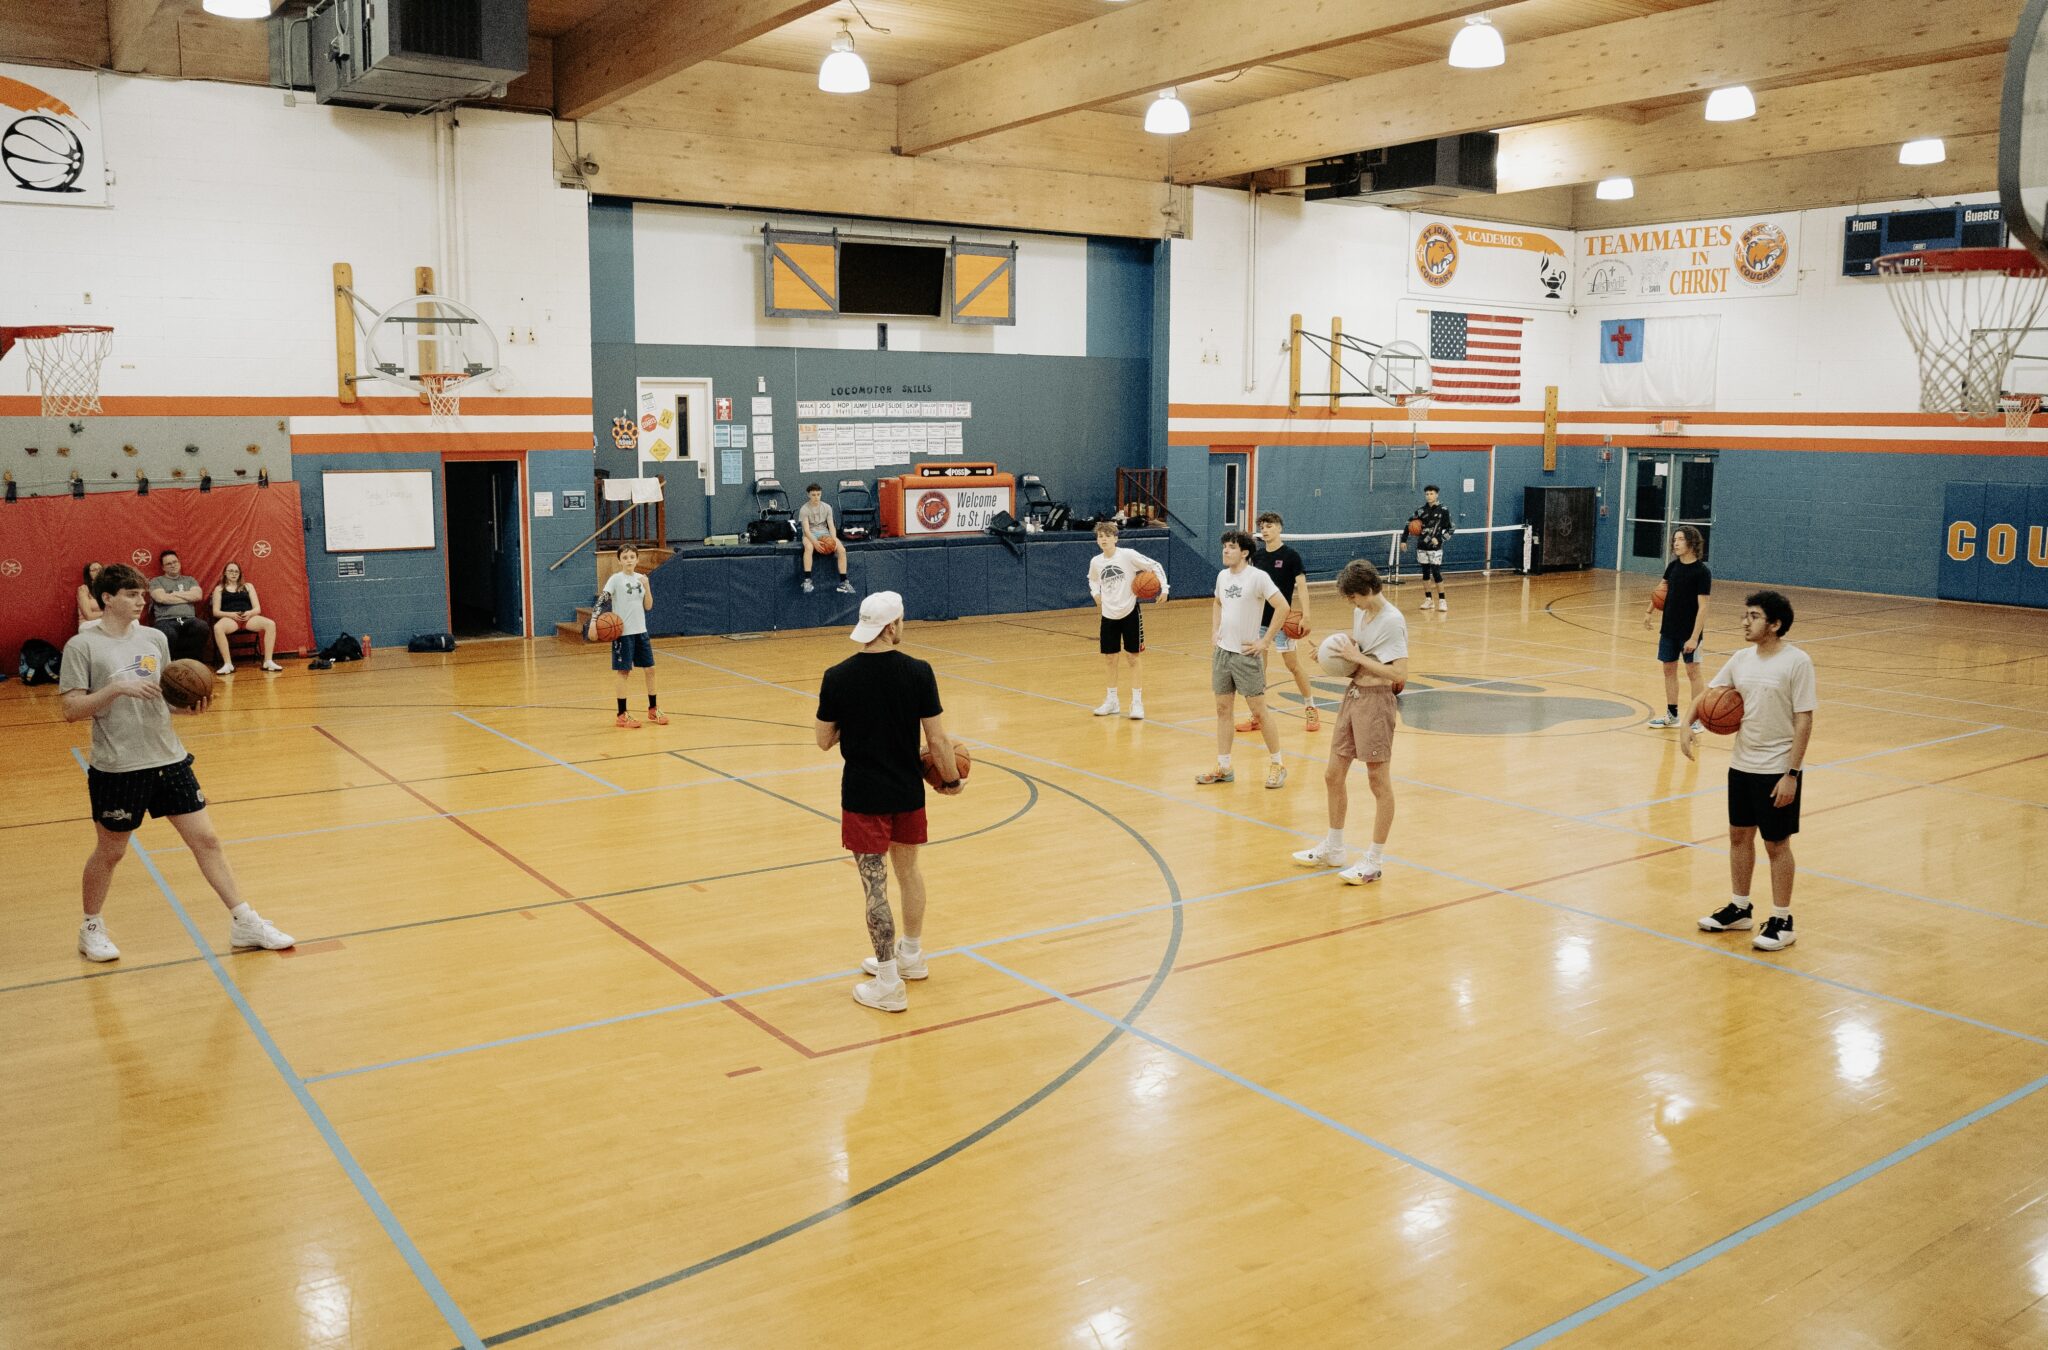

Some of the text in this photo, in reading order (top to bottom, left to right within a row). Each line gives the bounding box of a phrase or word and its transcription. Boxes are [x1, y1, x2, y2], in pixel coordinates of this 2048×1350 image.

[1964, 209, 2000, 222] Guests
[1852, 219, 1877, 232] Home
[1466, 231, 1523, 247] ACADEMICS
[1584, 225, 1733, 257] TEAMMATES
[1692, 250, 1710, 266] IN
[1421, 266, 1453, 284] COUGARS
[1740, 264, 1781, 281] COUGARS
[1669, 267, 1731, 295] CHRIST
[831, 384, 932, 396] LOCOMOTOR SKILLS
[951, 468, 965, 476] POSS
[957, 491, 997, 508] Welcome
[957, 512, 966, 527] to
[968, 511, 980, 527] St.
[1947, 521, 2048, 568] COU
